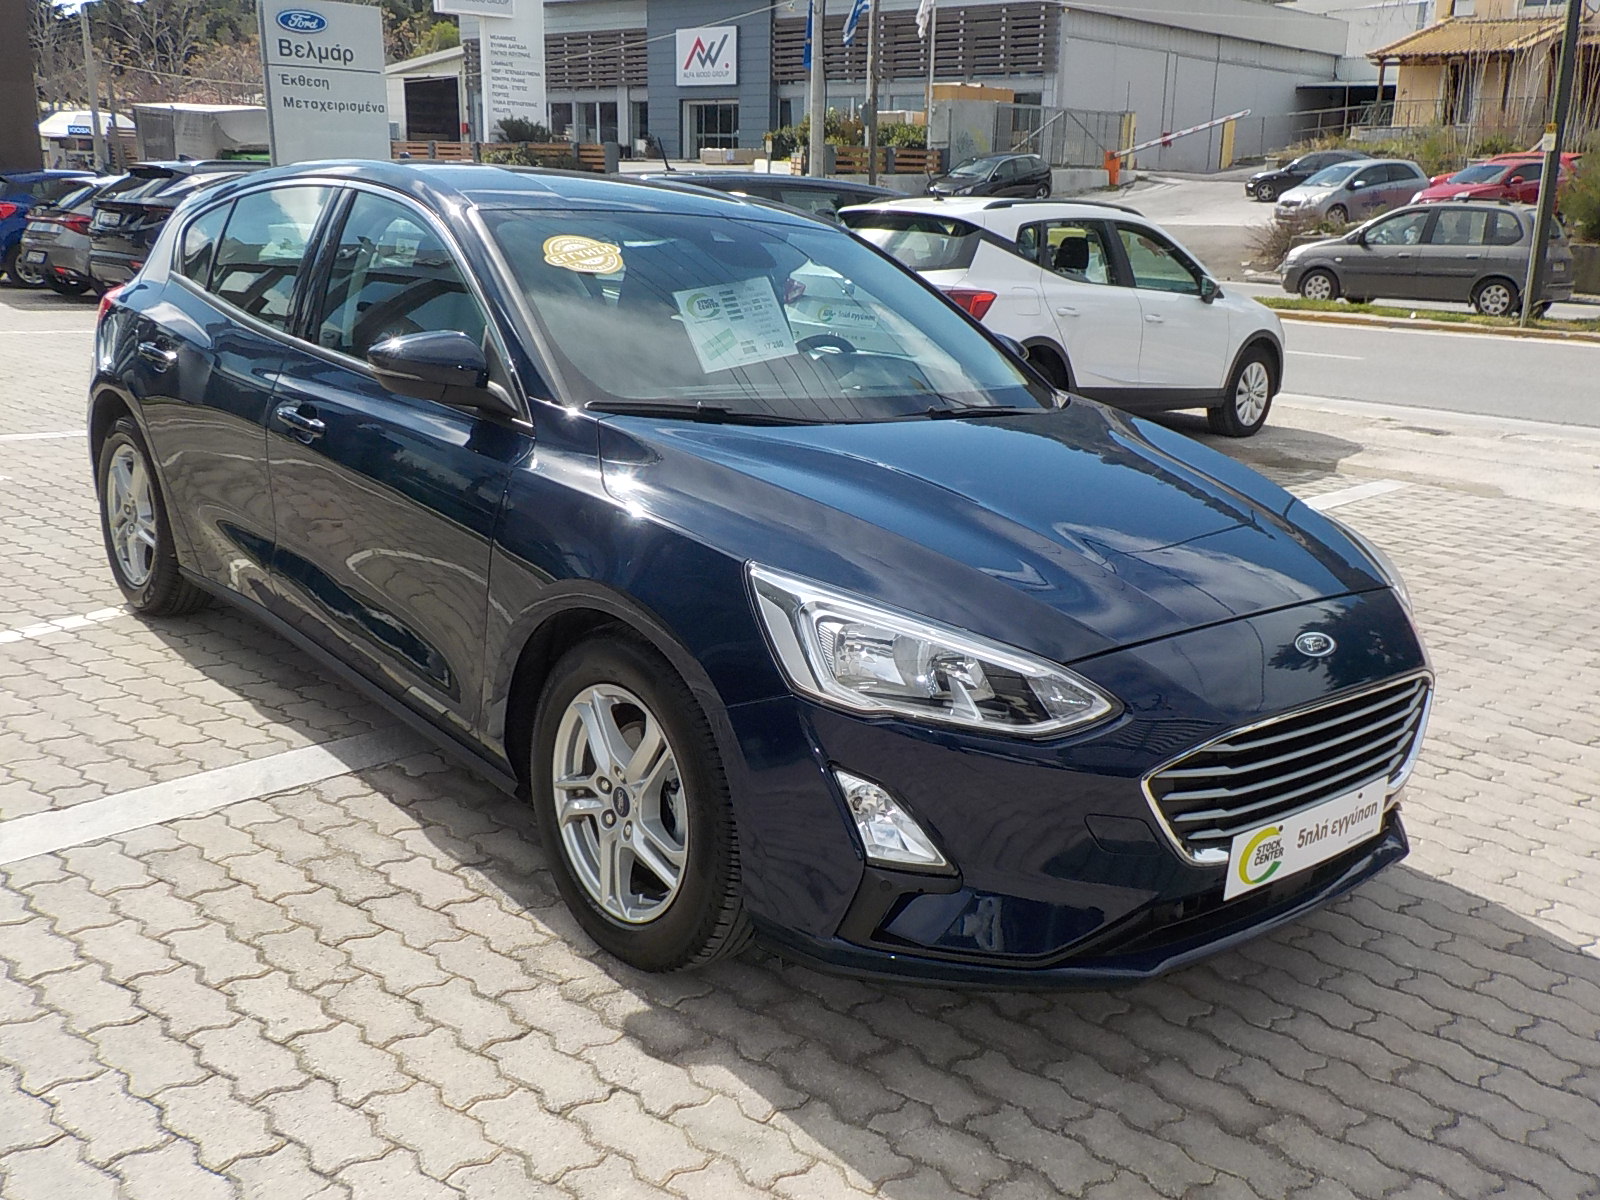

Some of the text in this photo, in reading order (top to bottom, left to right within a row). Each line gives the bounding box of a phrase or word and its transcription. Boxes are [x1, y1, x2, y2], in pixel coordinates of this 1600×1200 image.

[288, 13, 319, 29] Ford
[278, 38, 354, 66] Βελμάρ
[278, 74, 330, 90] Έκθεση
[282, 97, 386, 114] Μεταχειρισμένα
[549, 245, 614, 265] ΕΓΓΥΗΣΗ
[1297, 818, 1329, 849] 5πλή
[1256, 837, 1282, 856] STOCK
[1254, 847, 1285, 867] CENTER
